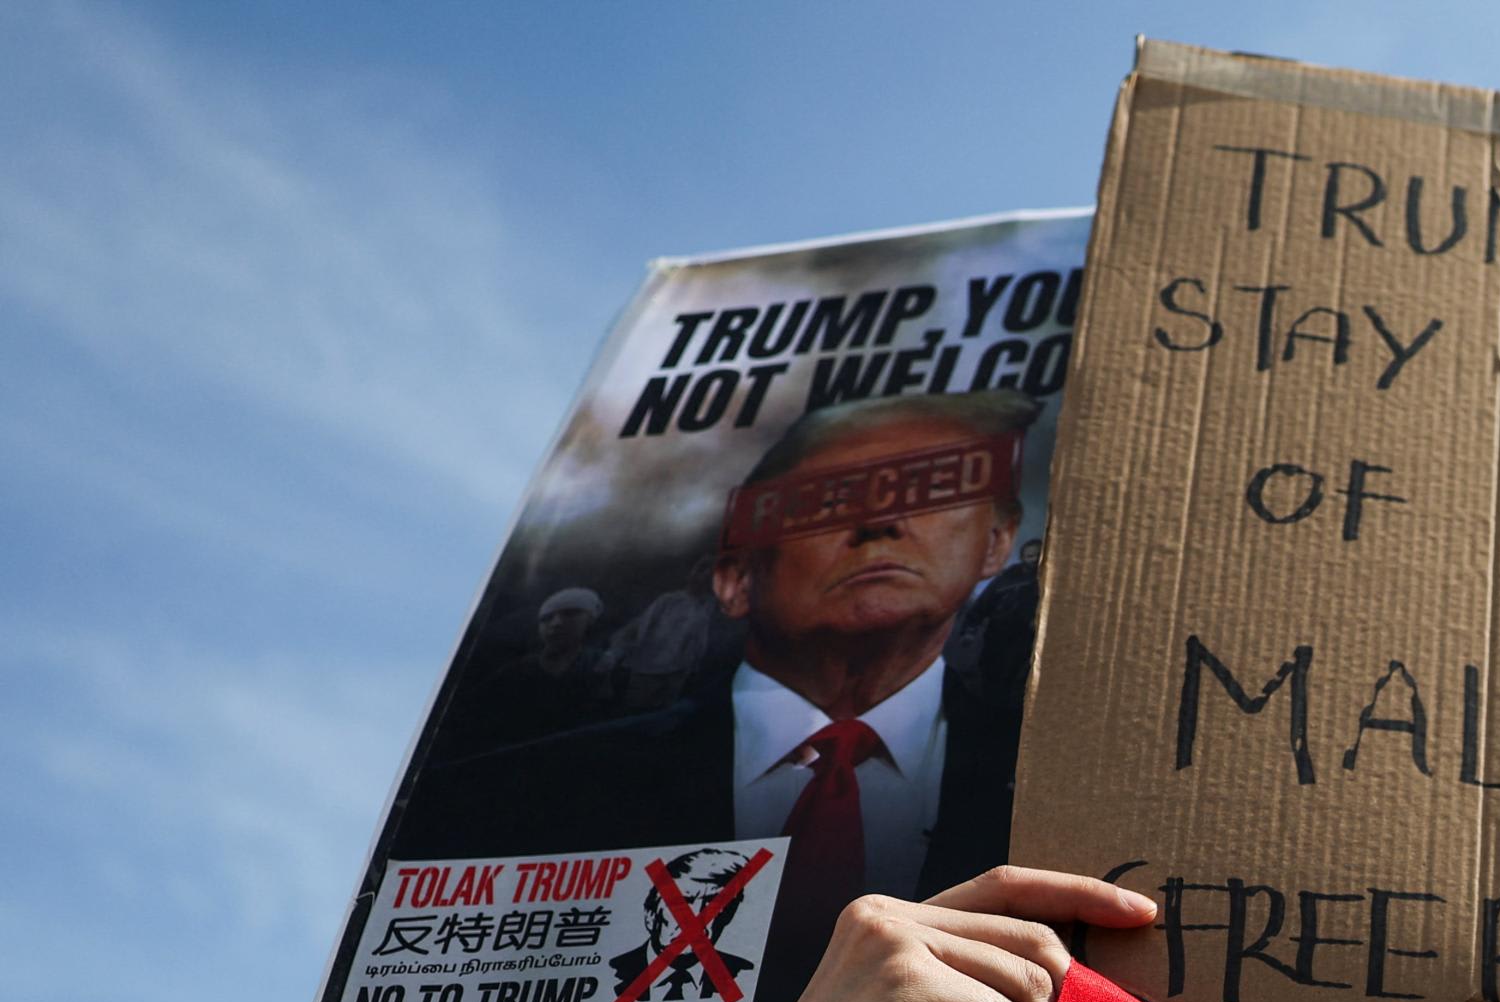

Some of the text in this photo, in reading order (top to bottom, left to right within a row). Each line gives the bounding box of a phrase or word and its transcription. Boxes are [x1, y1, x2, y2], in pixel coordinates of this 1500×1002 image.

[660, 284, 945, 370] TRUMP,
[1153, 277, 1444, 391] STAY
[618, 364, 789, 439] NOT
[1246, 459, 1408, 542] OF
[393, 856, 633, 909] TOLAK TRUMP
[371, 906, 612, 956] 反特朗普
[459, 951, 602, 977] நிராகரிப்போம்
